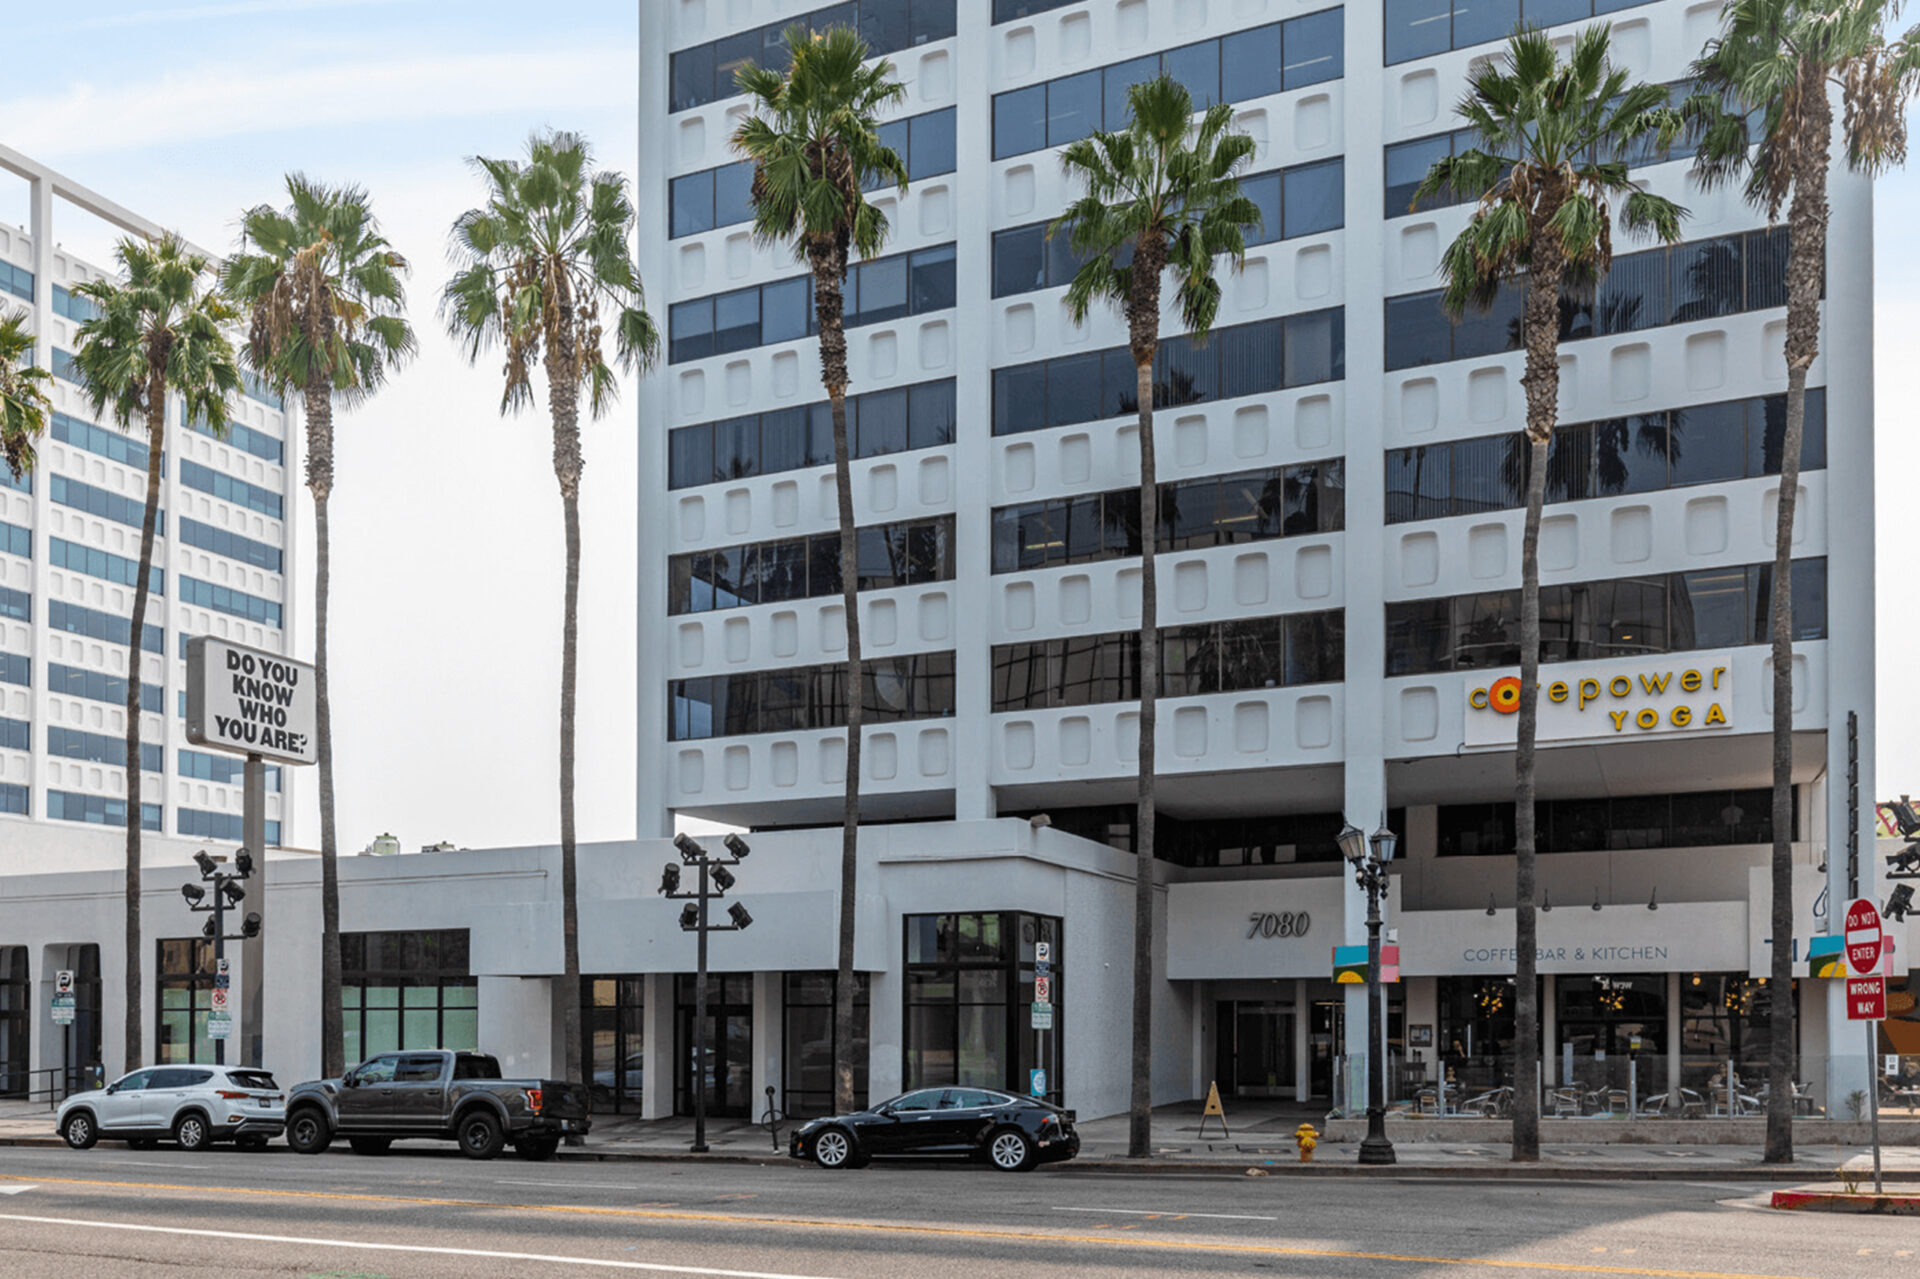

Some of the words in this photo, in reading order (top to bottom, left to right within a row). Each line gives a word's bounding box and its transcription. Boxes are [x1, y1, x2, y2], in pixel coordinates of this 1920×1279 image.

[226, 649, 255, 675] DO
[258, 658, 298, 687] YOU
[232, 673, 294, 707] KNOW
[1469, 666, 1727, 714] coepower
[238, 698, 287, 727] WHO
[1609, 703, 1726, 731] YOGA
[214, 715, 257, 743] YOU
[259, 727, 308, 754] ARE?
[1246, 910, 1310, 939] 7080
[1848, 914, 1858, 927] DO
[1861, 911, 1876, 925] NOT
[1535, 947, 1566, 961] BAR
[1574, 948, 1585, 961] &
[1592, 946, 1668, 960] KITCHEN
[1852, 946, 1875, 961] ENTER
[1850, 981, 1880, 995] WRONG
[1857, 1001, 1875, 1013] WAY
